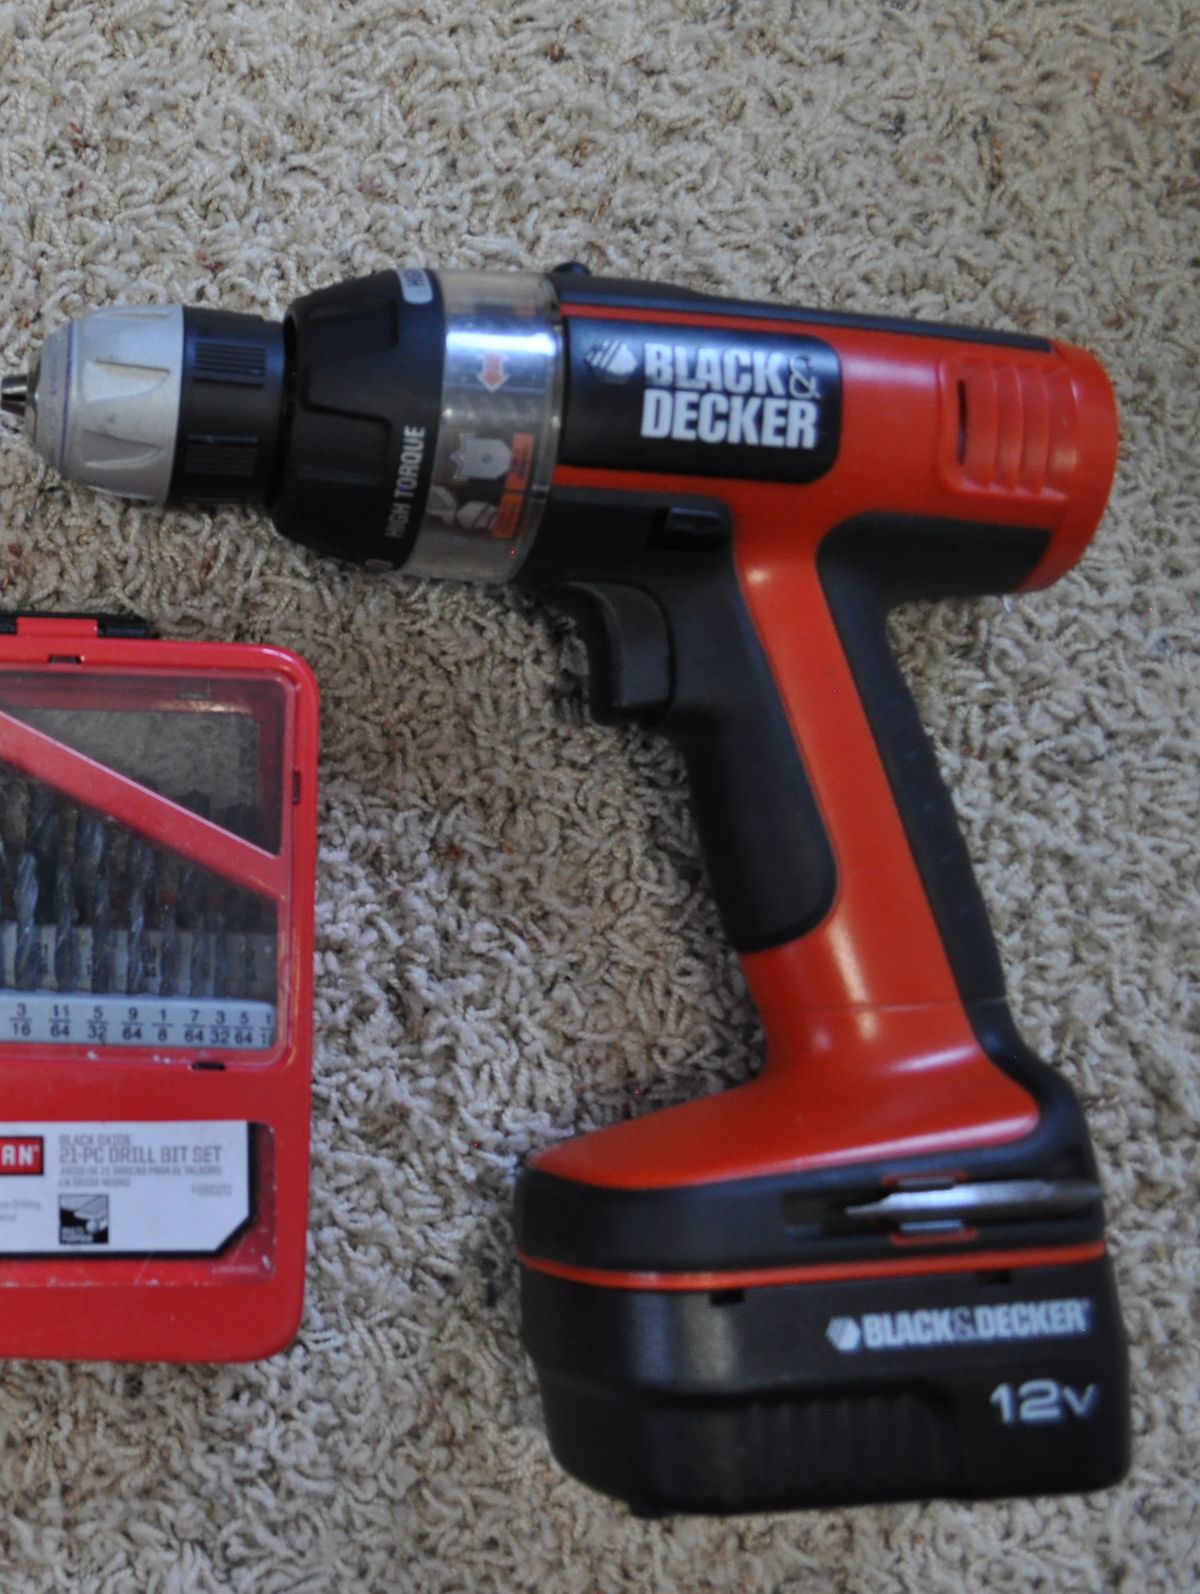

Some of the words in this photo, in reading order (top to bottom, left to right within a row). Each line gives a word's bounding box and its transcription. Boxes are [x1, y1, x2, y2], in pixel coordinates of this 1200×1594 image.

[641, 388, 818, 449] DECKER
[394, 425, 426, 499] TORQUE
[384, 502, 412, 538] HIGH
[59, 1146, 104, 1164] 21-PC
[109, 1146, 157, 1164] DRILL
[161, 1146, 188, 1163] BIT
[192, 1145, 223, 1163] SET
[862, 1300, 1085, 1350] BLACK&DECKER
